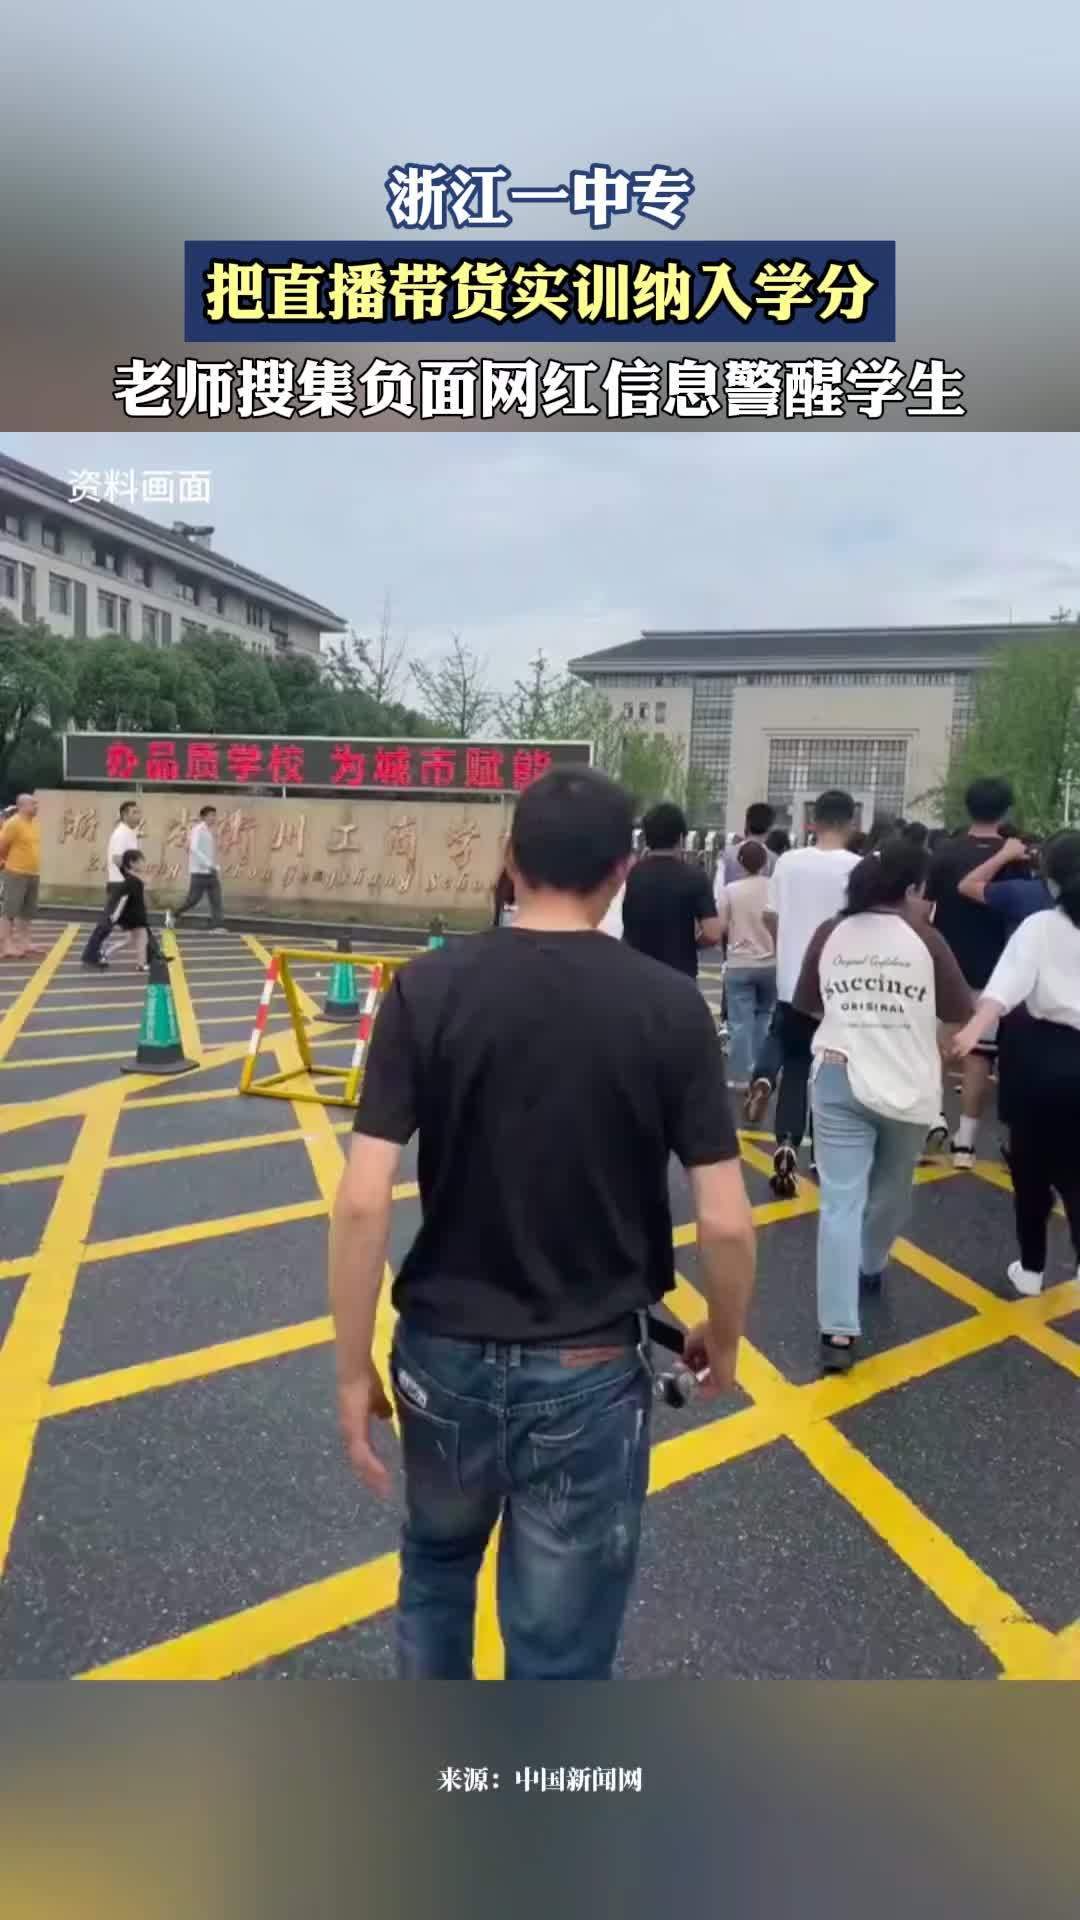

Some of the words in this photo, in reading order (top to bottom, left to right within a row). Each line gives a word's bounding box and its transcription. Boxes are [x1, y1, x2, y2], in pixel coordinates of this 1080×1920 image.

[106, 741, 304, 783] 办品质学校
[331, 744, 552, 789] 为城市赋能
